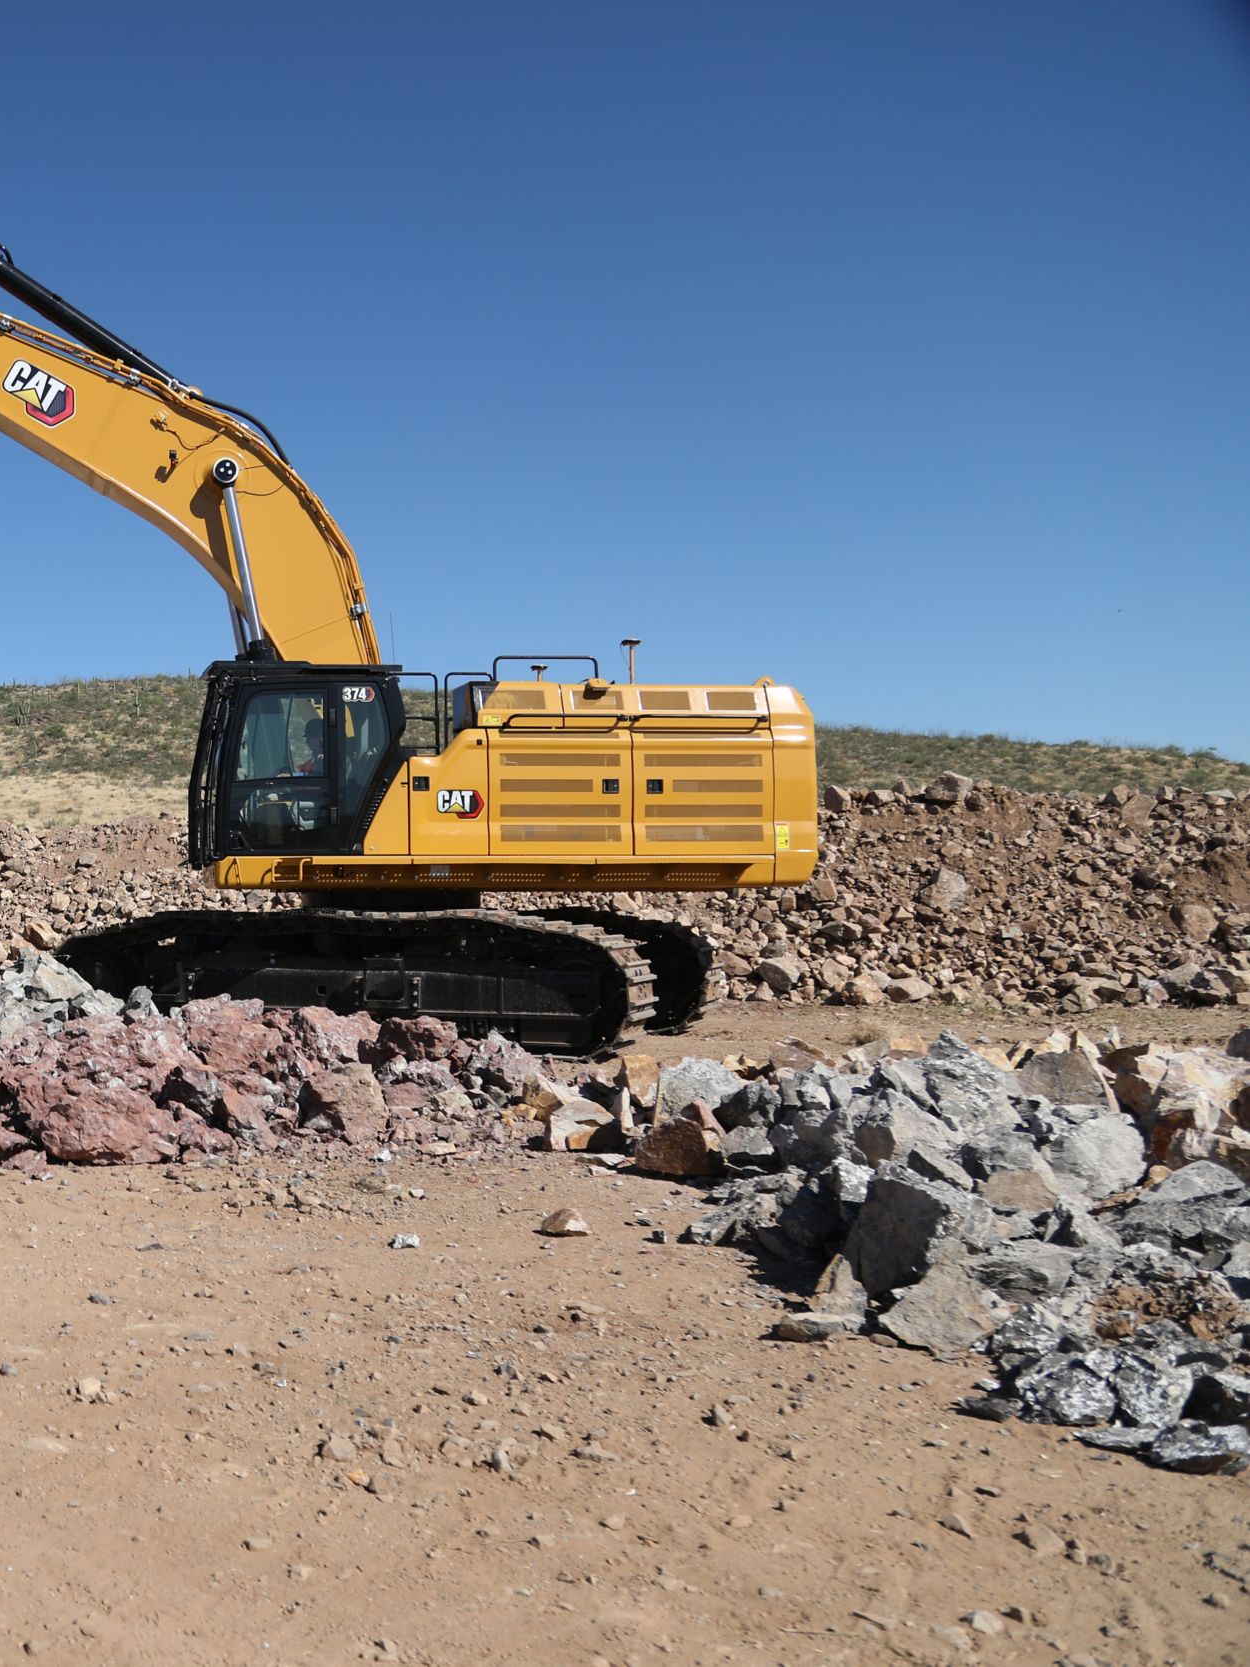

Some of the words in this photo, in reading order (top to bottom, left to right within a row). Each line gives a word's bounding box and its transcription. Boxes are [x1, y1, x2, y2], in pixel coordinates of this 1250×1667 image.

[3, 360, 67, 412] CAT
[342, 687, 367, 701] 374
[437, 790, 474, 813] CAT
